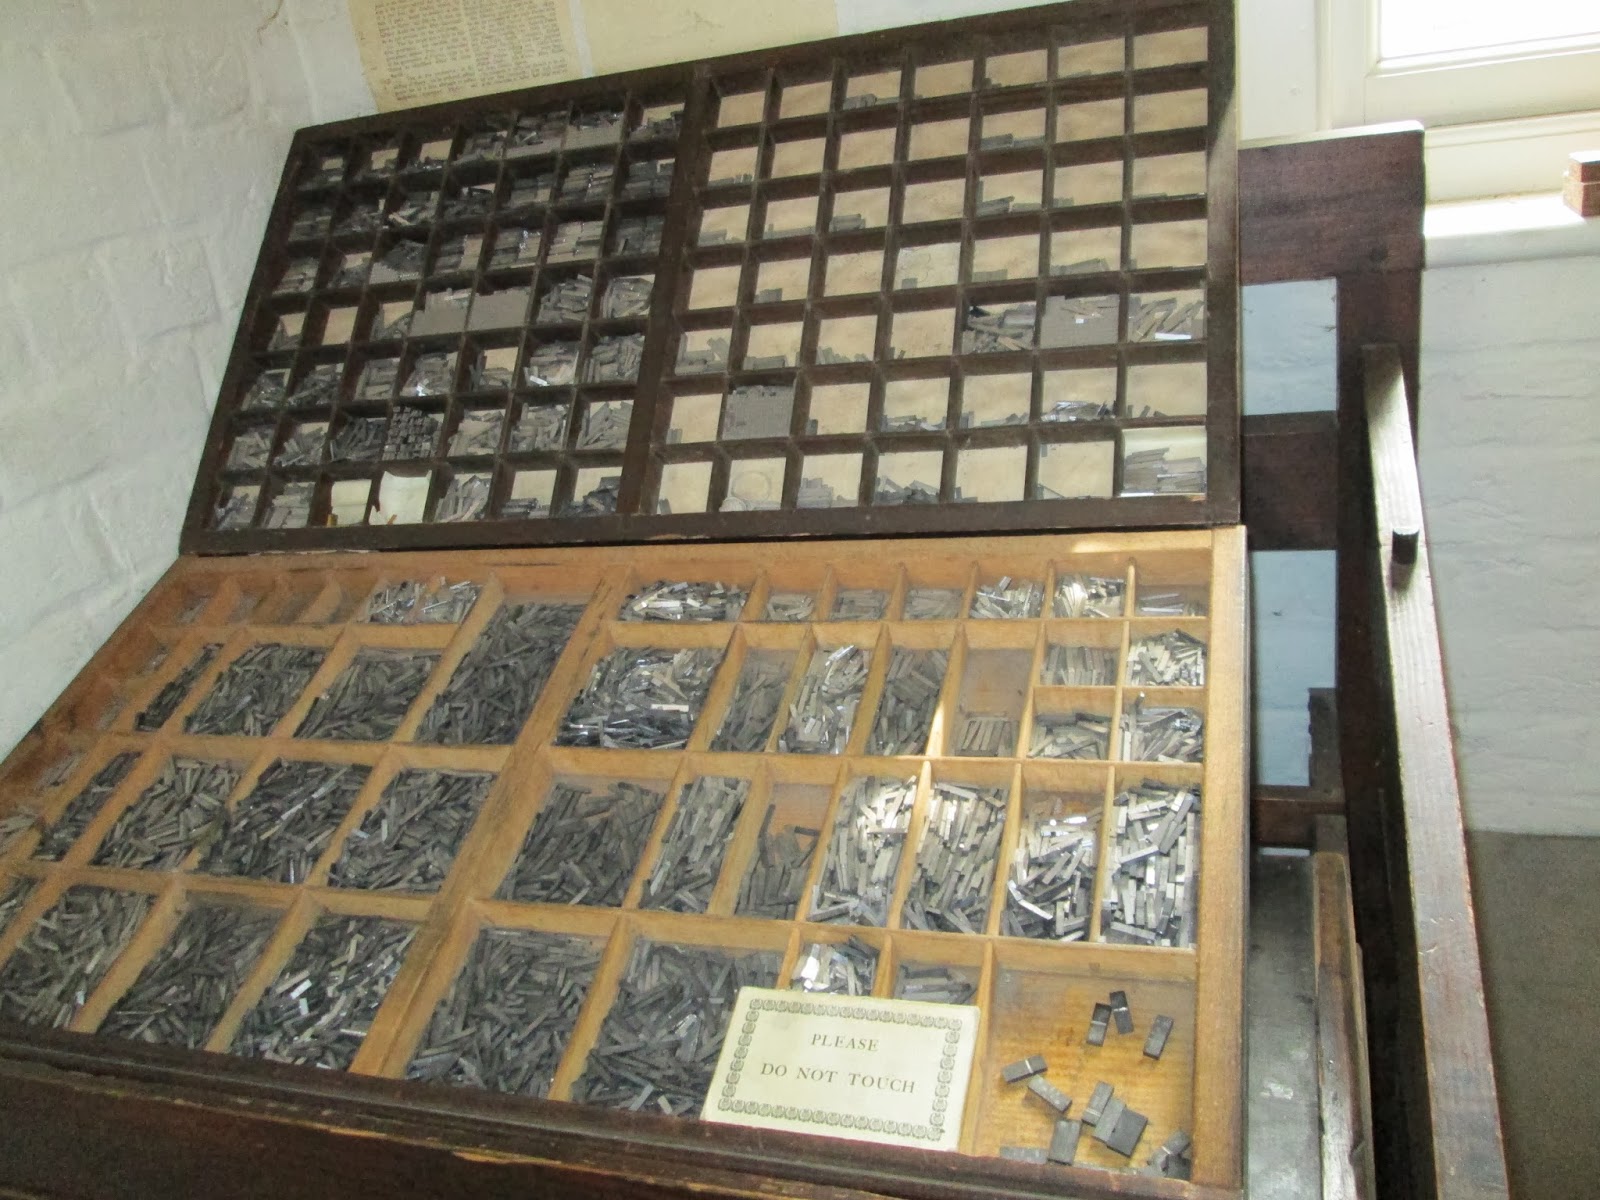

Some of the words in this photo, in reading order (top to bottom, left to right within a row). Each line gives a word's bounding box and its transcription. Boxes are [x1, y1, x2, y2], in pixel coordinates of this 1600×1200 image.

[811, 1033, 879, 1052] PLEASE
[760, 1062, 788, 1077] DO
[796, 1067, 838, 1083] NOT
[848, 1072, 916, 1094] TOUCH
